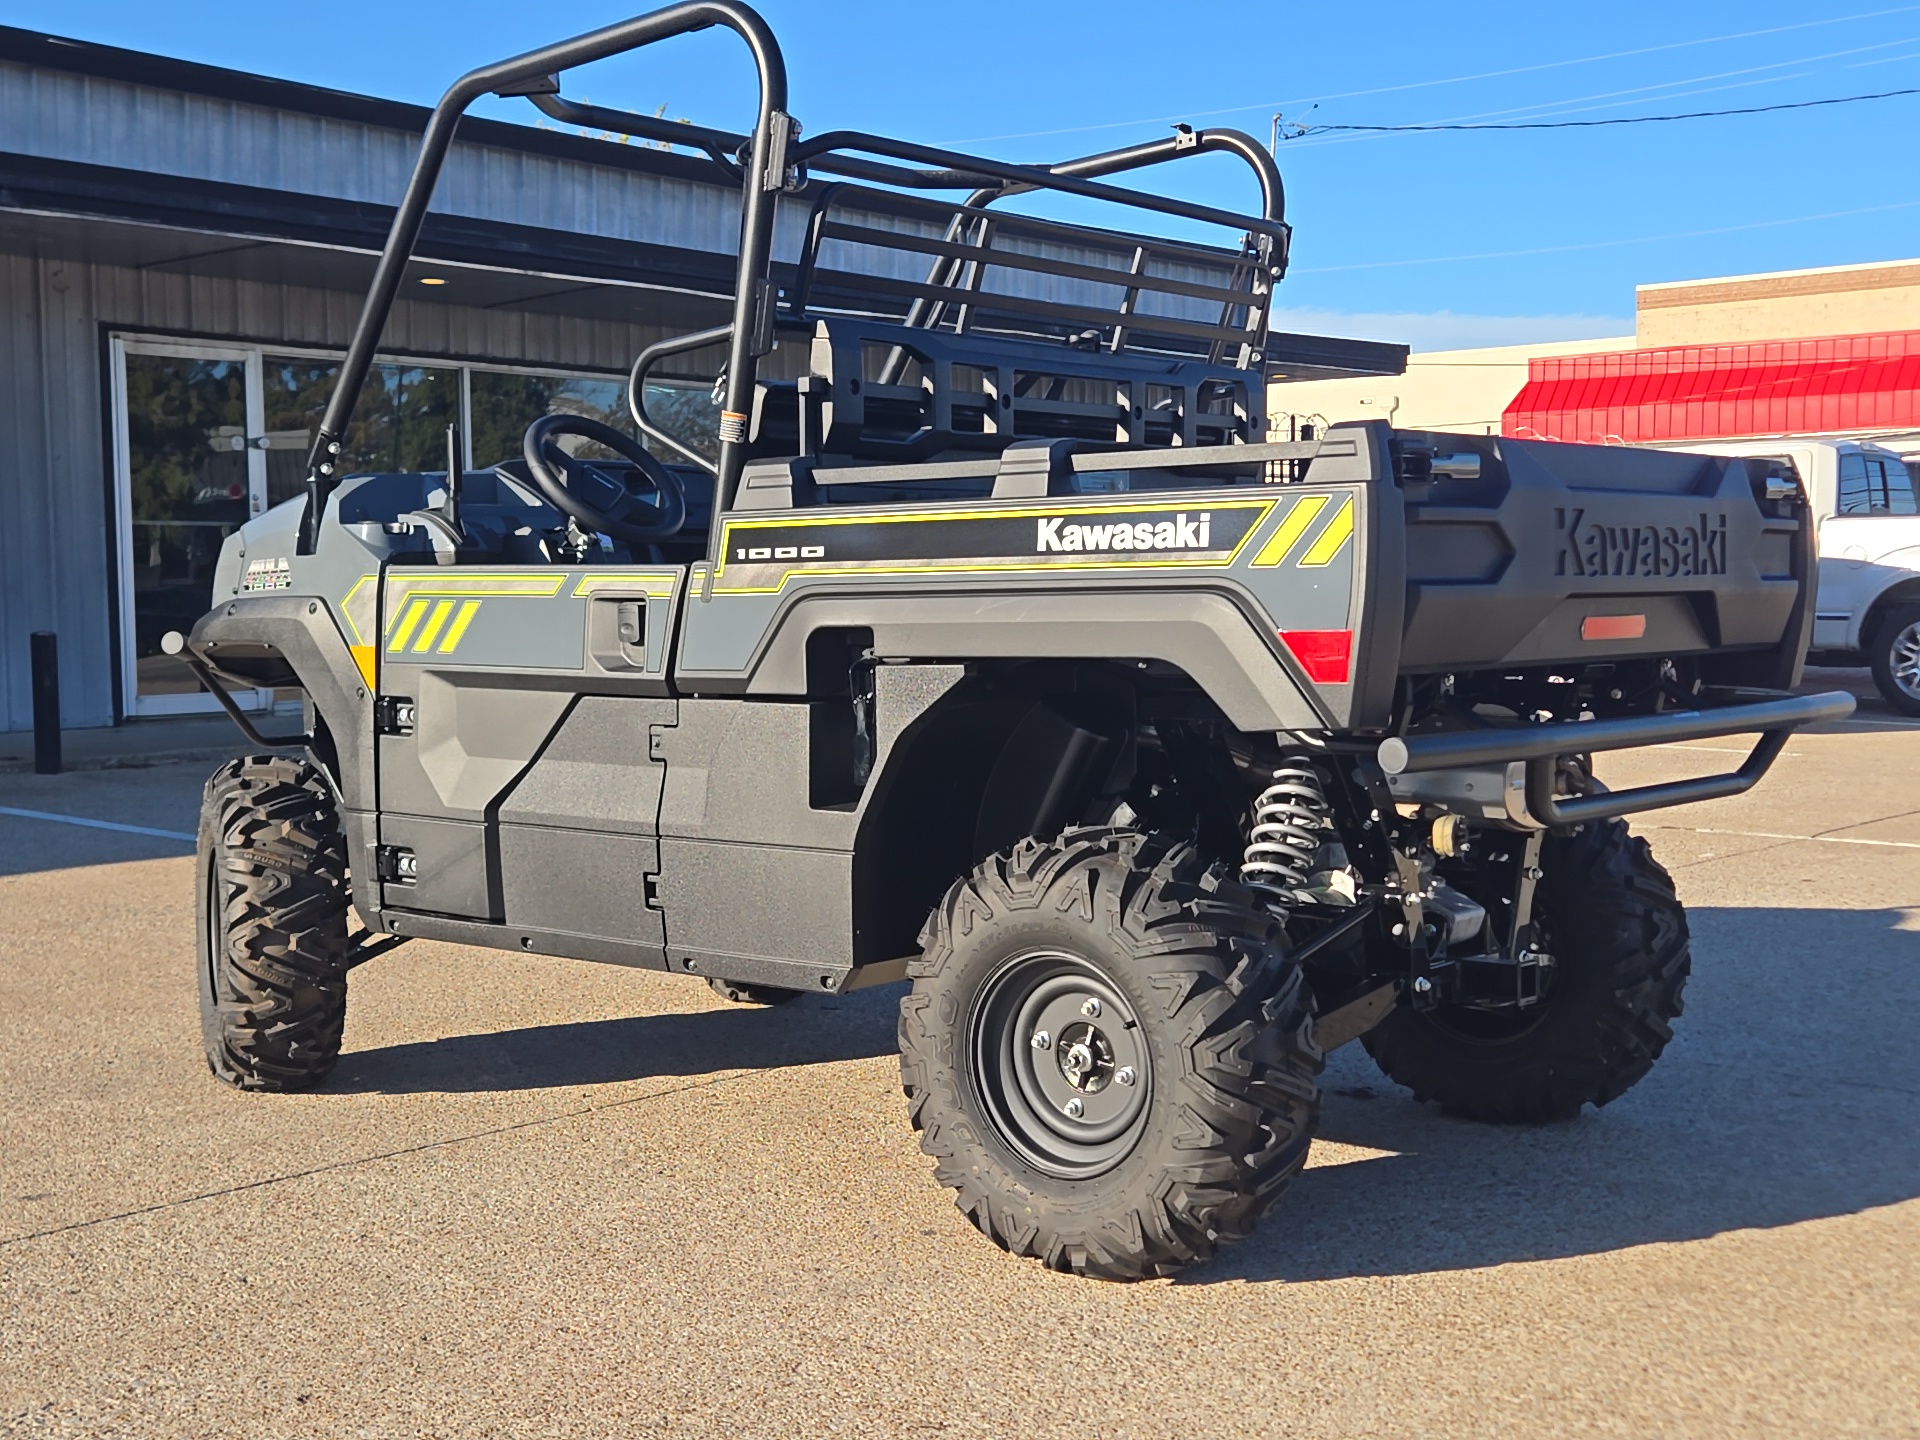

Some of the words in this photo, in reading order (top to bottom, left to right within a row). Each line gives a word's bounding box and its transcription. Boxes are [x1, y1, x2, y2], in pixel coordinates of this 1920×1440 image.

[736, 546, 825, 560] 1000
[1036, 512, 1211, 552] Kawasaki
[1554, 507, 1727, 577] Kawasaki
[932, 989, 984, 1148] DURO
